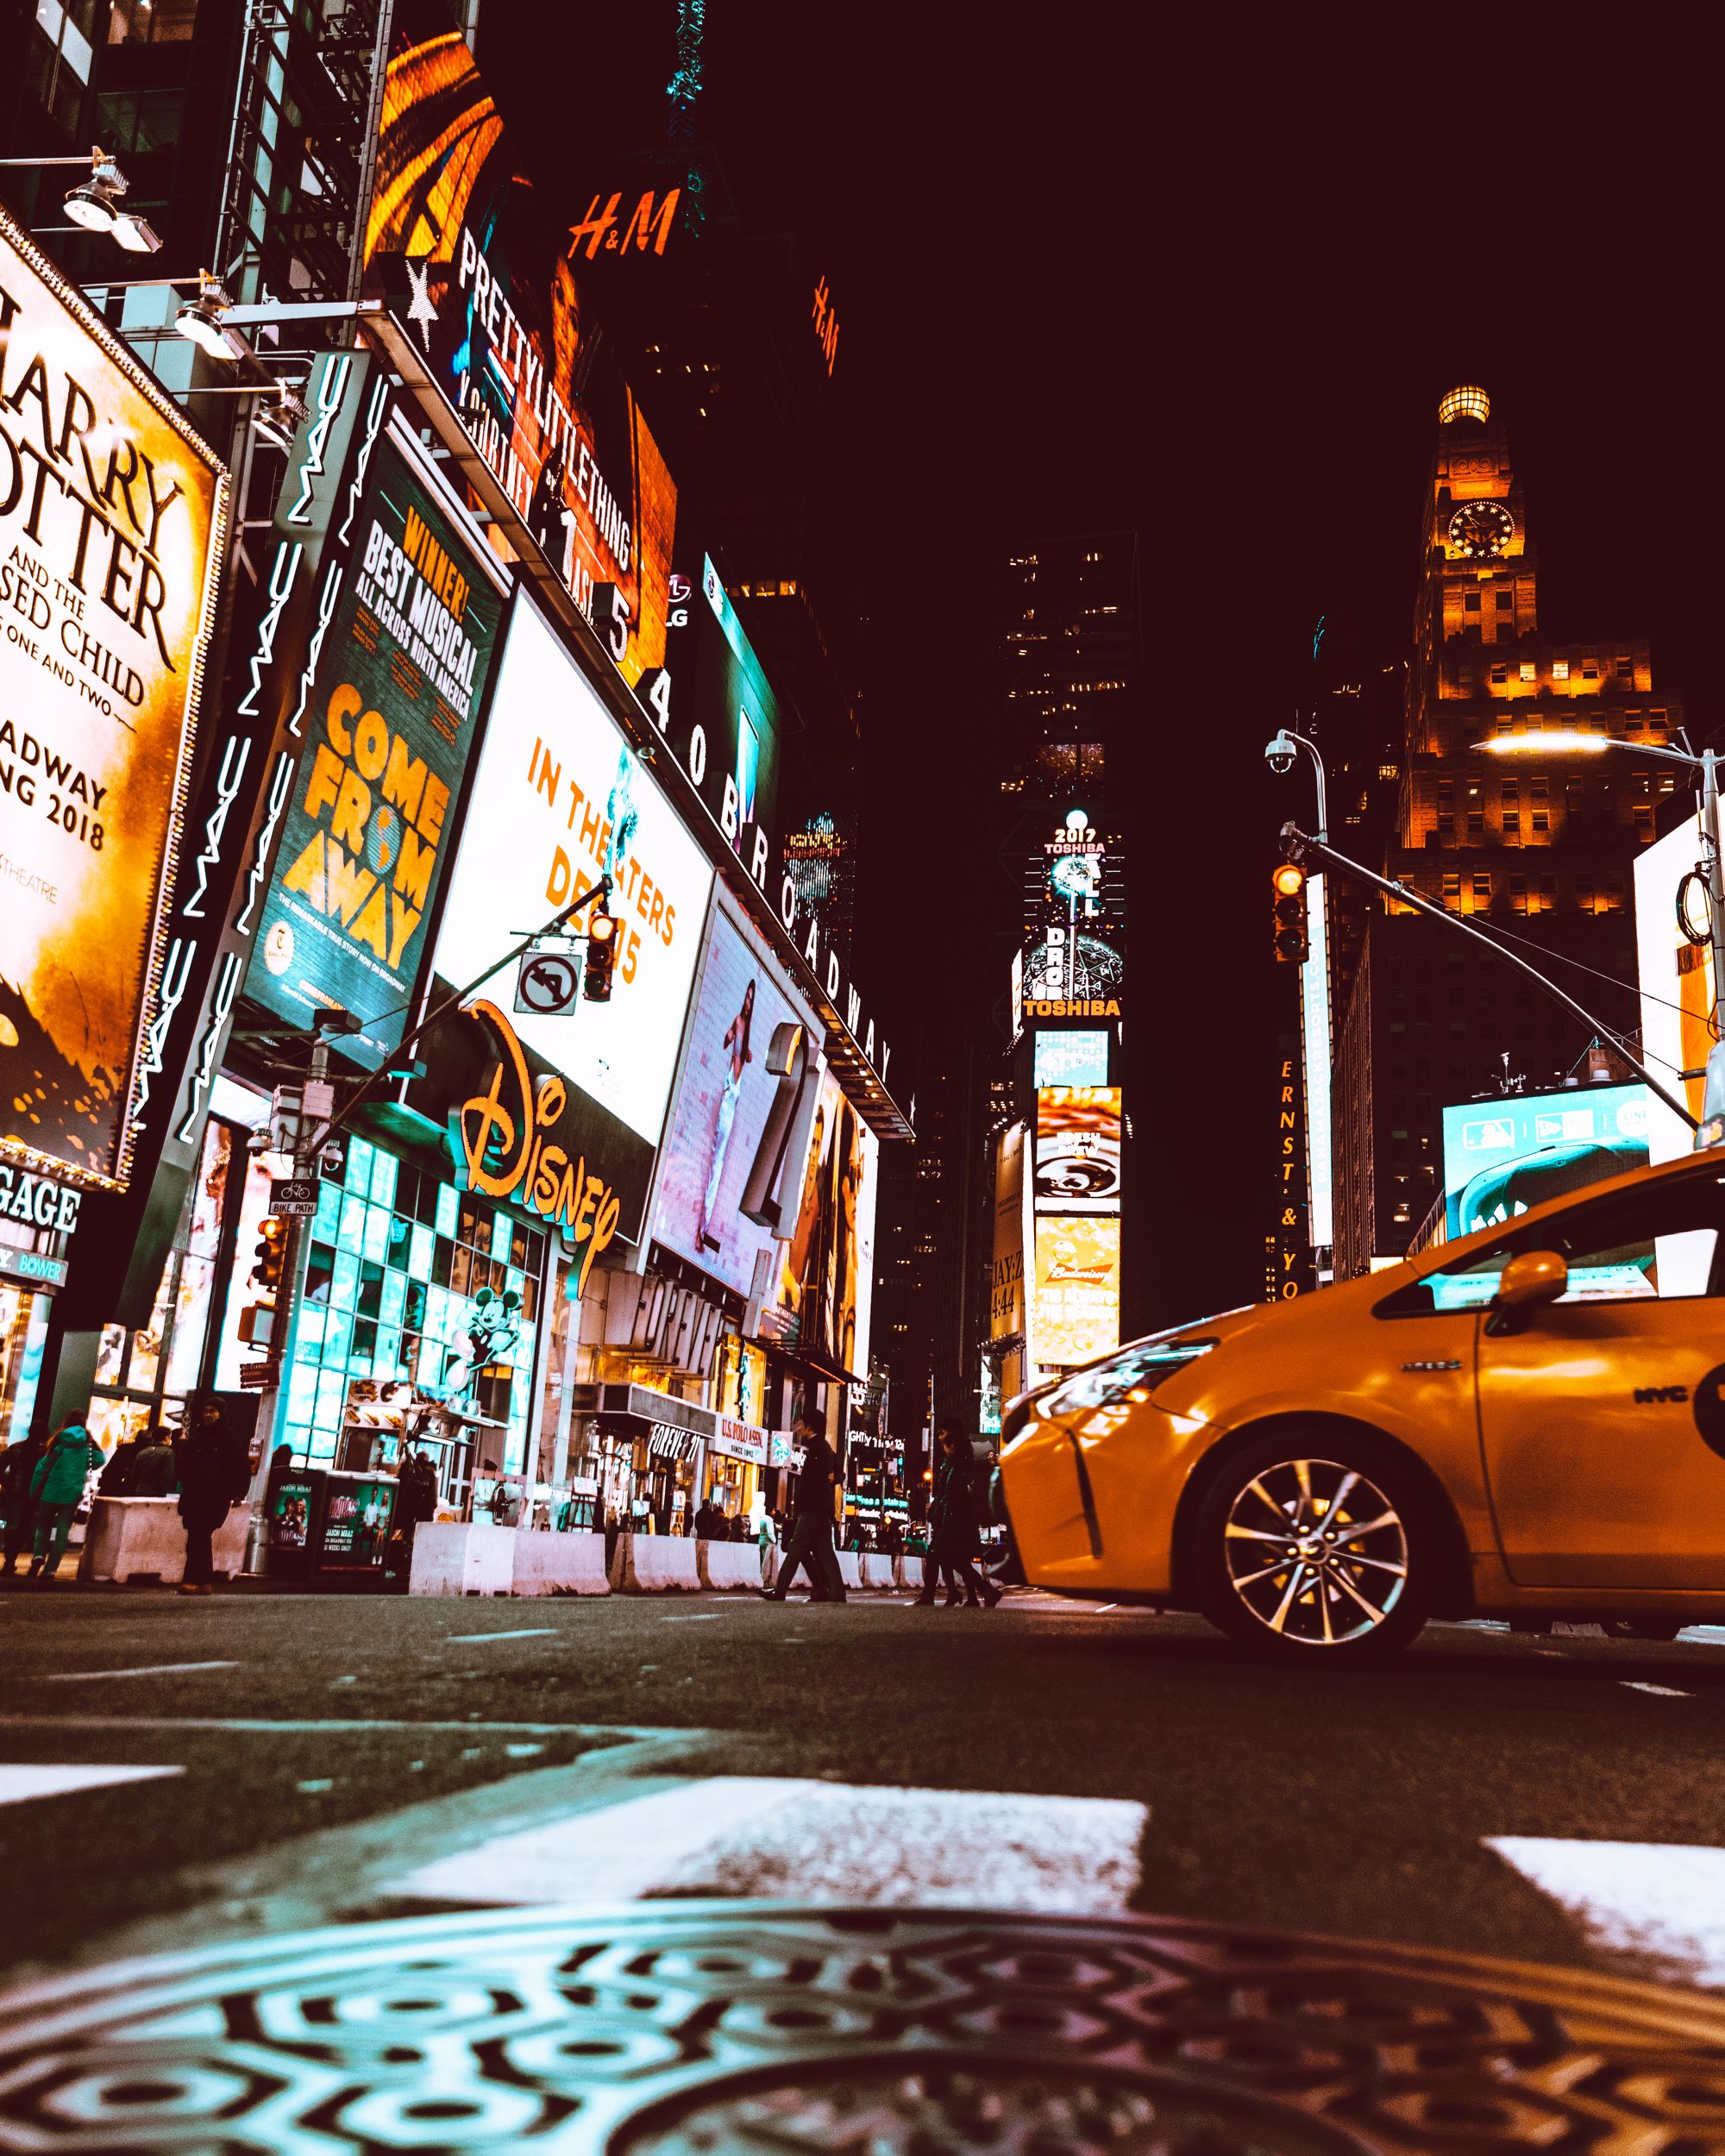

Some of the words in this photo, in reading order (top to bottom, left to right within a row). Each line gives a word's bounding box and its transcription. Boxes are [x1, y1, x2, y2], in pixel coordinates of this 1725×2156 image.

[567, 188, 681, 260] H&M
[812, 276, 840, 378] H&M
[9, 545, 49, 588] AND
[54, 578, 85, 620] THE
[403, 505, 470, 624] WINNER!
[362, 518, 415, 611] BEST
[408, 576, 477, 697] MUSICAL
[7, 624, 40, 661] ONE
[42, 653, 75, 688] AND
[78, 684, 112, 717] TWO
[60, 619, 145, 707] CHILD
[354, 571, 375, 610] ALL
[373, 592, 412, 650] ACROSS
[410, 634, 439, 683] NORTH
[435, 666, 471, 722] AMERICA
[326, 683, 450, 846] COME
[527, 736, 561, 808] IN
[47, 793, 104, 852] 2018
[1044, 843, 1106, 854] TOSHIBA
[1055, 829, 1096, 843] 2017
[3, 856, 59, 905] THEATRE
[282, 830, 423, 970] AWAY
[279, 893, 291, 908] THE
[290, 899, 329, 936] REMARKABLE
[328, 928, 343, 946] TRUE
[342, 937, 360, 957] STORY
[358, 950, 373, 968] NOW
[371, 962, 381, 975] ON
[380, 966, 406, 993] BROADWAY
[1023, 1000, 1121, 1017] TOSHIBA
[1309, 937, 1328, 1184] PANAMAJACKRESORTS.COM
[1281, 1061, 1295, 1181] ERNST
[1624, 1110, 1648, 1120] LINE
[273, 1203, 292, 1213] BIKE
[295, 1203, 314, 1213] PATH
[1282, 1207, 1296, 1225] &
[19, 1253, 61, 1281] BOWER
[992, 1285, 1015, 1319] 4:44
[1634, 1385, 1689, 1404] NYC
[722, 1419, 733, 1439] U.S.
[733, 1424, 749, 1444] POLO
[731, 1445, 744, 1456] SINCE
